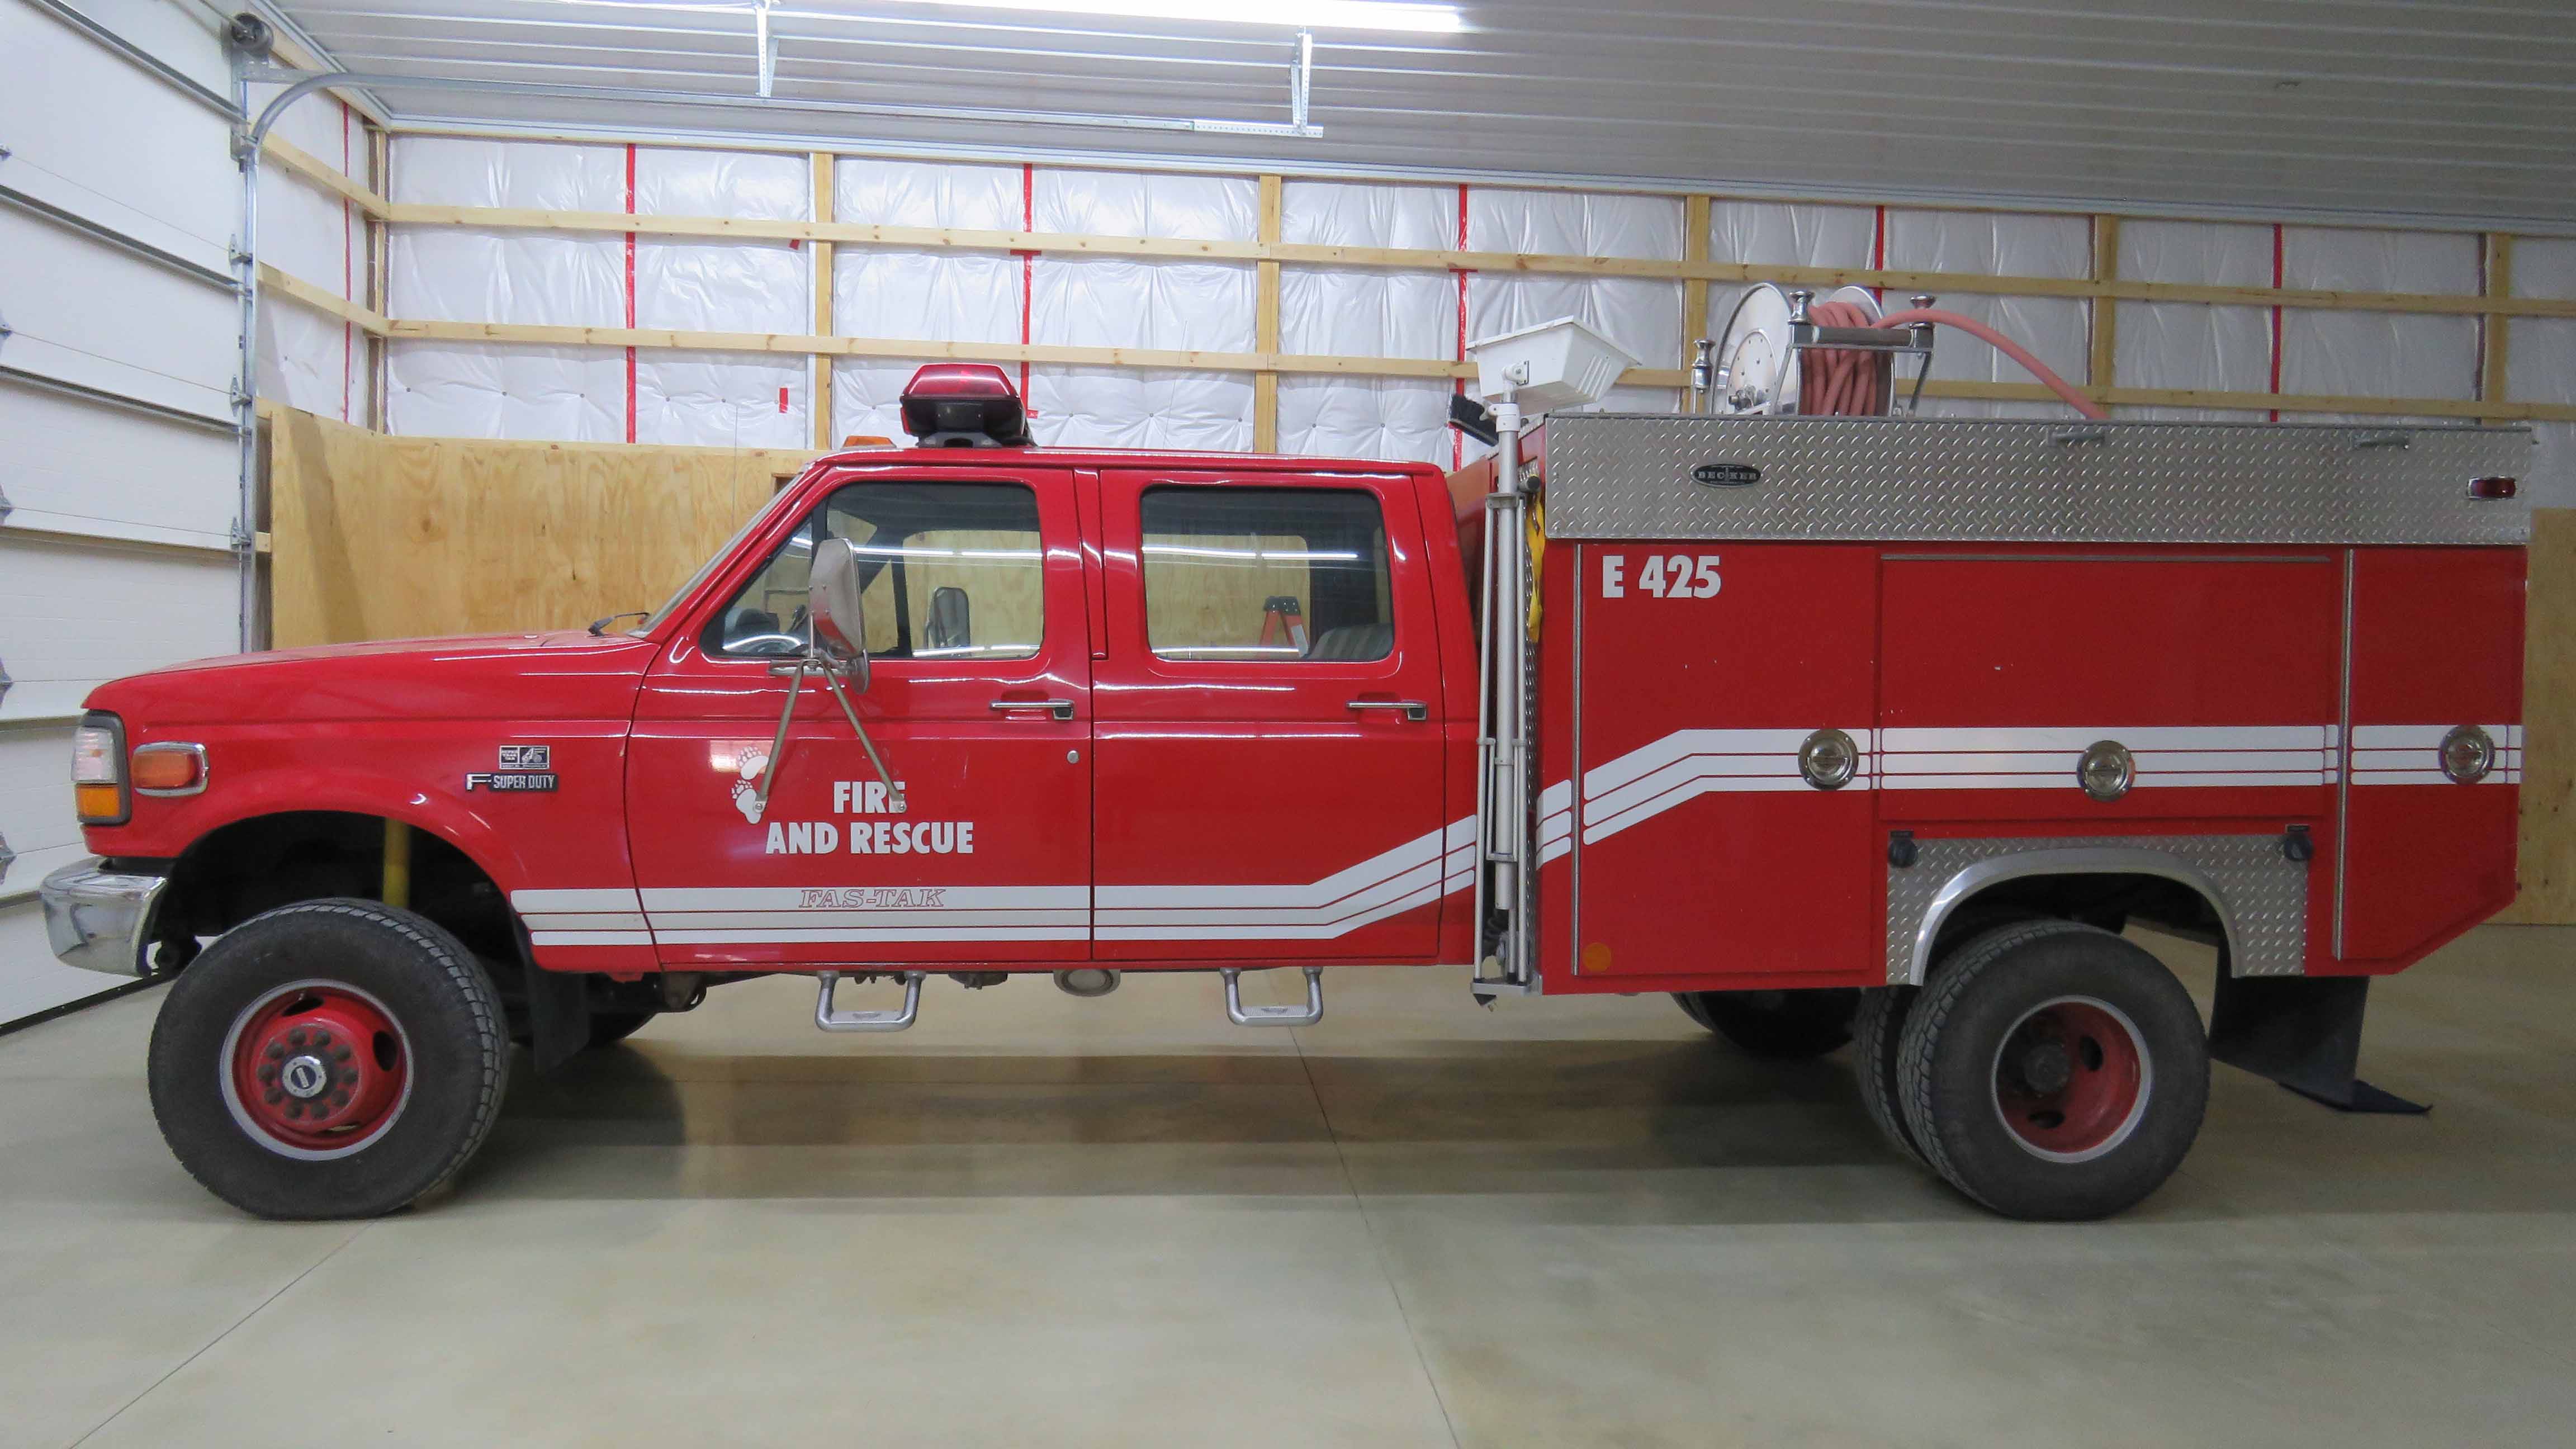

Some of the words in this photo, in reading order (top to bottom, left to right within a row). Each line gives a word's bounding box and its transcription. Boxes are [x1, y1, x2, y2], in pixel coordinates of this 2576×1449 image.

[1698, 471, 1758, 480] BECKER
[1602, 555, 1623, 598] E
[1639, 555, 1721, 599] 425
[493, 775, 526, 789] SUPER
[528, 775, 555, 789] DUTY
[765, 822, 839, 854] AND
[850, 822, 973, 854] RESCUE
[798, 889, 946, 908] FAS-TAK
